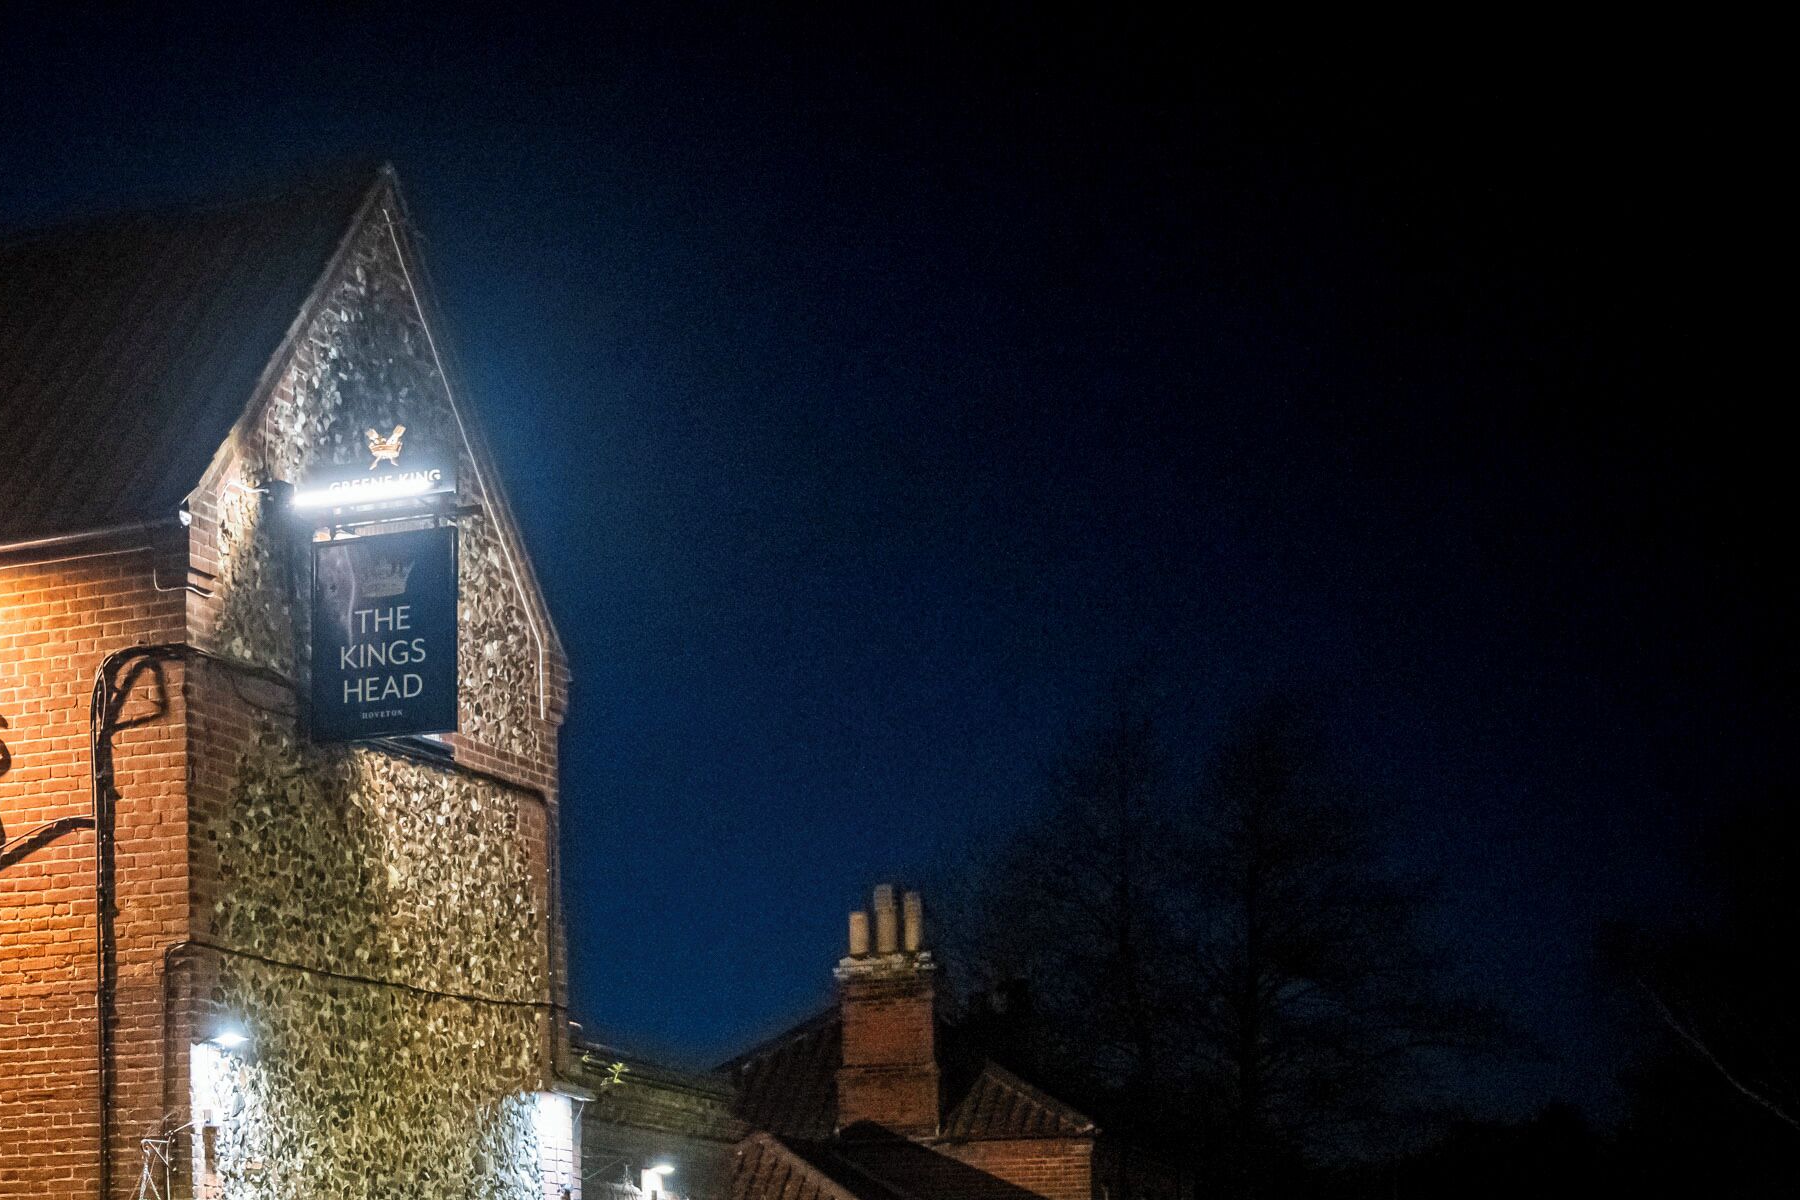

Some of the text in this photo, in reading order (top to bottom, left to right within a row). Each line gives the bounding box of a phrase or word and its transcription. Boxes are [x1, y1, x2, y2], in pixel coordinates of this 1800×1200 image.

[355, 605, 411, 634] THE
[340, 637, 426, 670] KINGS
[343, 673, 423, 704] HEAD
[362, 709, 403, 720] HOVETON
